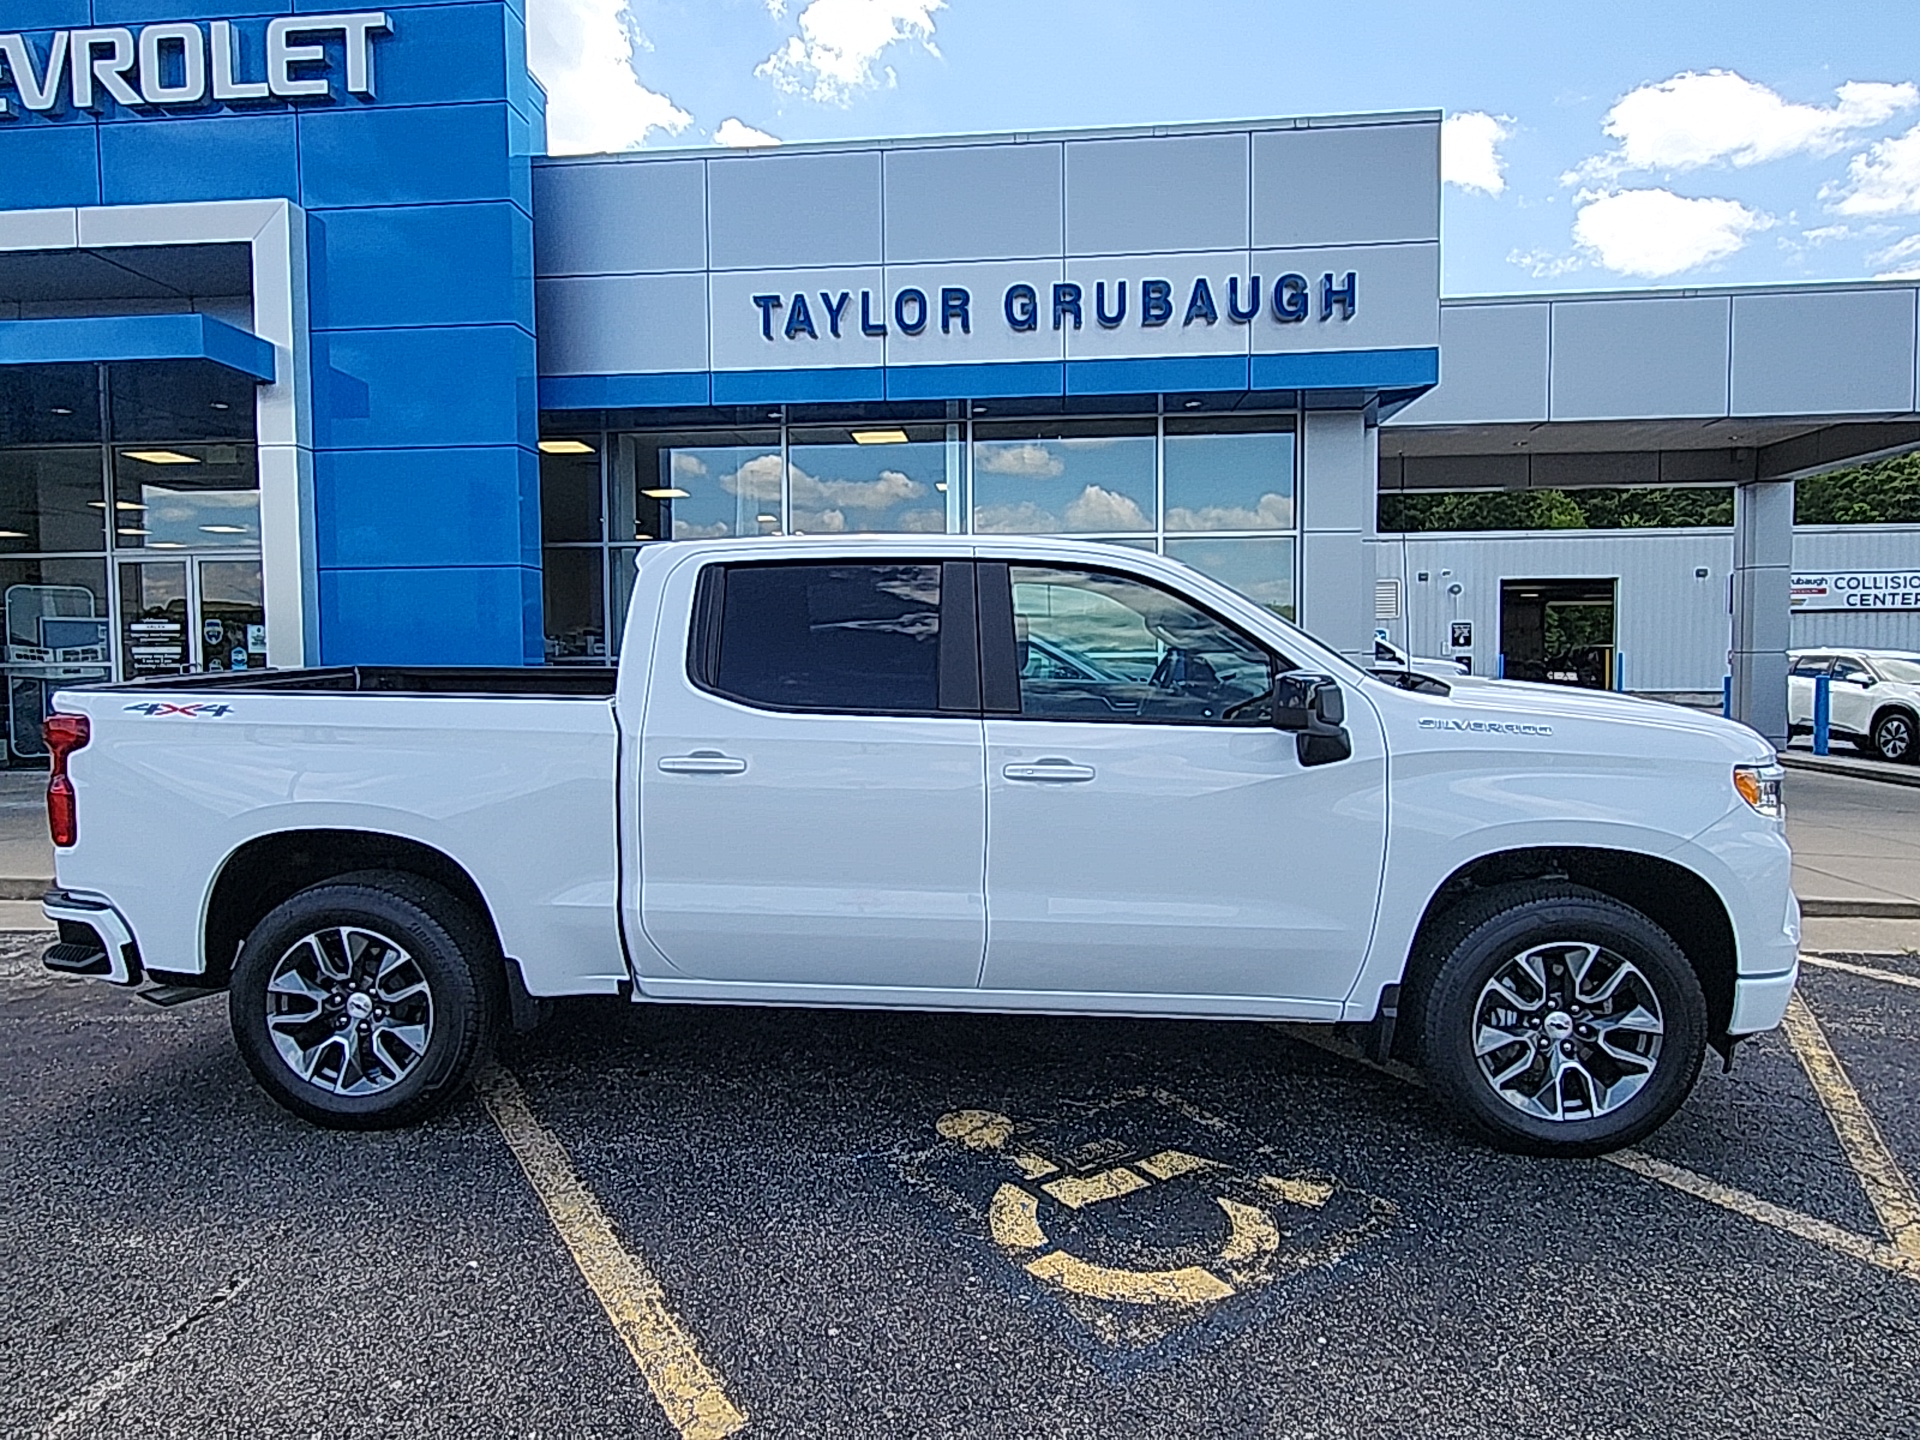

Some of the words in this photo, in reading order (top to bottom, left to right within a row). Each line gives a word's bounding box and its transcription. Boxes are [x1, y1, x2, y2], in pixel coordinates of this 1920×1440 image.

[0, 12, 388, 112] VROLET
[753, 287, 971, 340] TAYLOR
[1004, 272, 1357, 332] GRUBAUGH
[1418, 718, 1553, 736] SILVERADO
